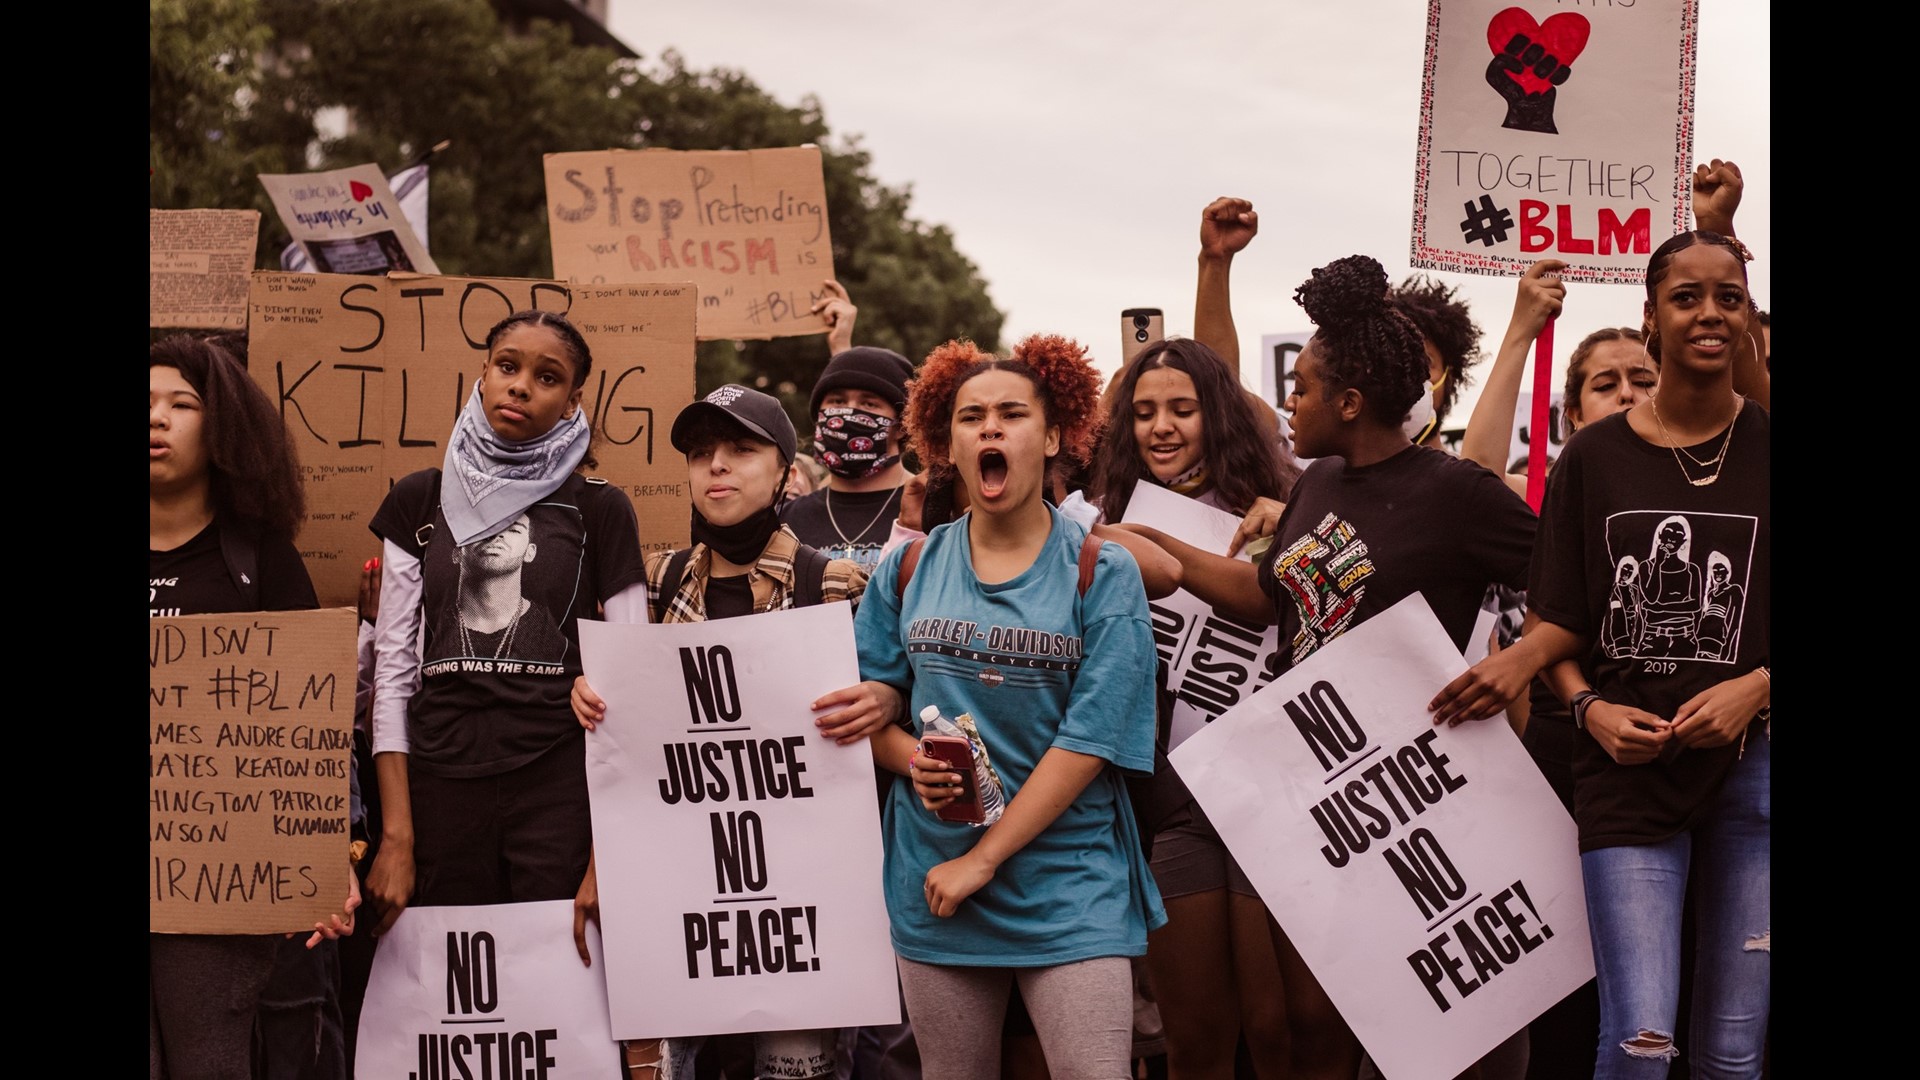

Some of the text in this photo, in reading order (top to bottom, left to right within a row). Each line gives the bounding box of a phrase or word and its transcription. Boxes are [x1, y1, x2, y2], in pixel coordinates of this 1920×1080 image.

[1441, 151, 1660, 202] TOGETHER
[366, 201, 389, 220] In
[555, 165, 823, 245] Stop Pretending
[1460, 194, 1651, 256] #BLM
[587, 241, 618, 263] your
[625, 234, 779, 275] RACISM
[1410, 258, 1437, 270] BLACK
[1440, 263, 1460, 273] LIVES
[1465, 266, 1506, 277] MATTER
[1430, 254, 1460, 264] JUSTICE
[1478, 261, 1503, 269] PEACE
[1491, 255, 1515, 263] BLACK
[291, 277, 316, 287] WANNA
[628, 289, 649, 297] HAVE
[663, 288, 686, 296] GUN"
[265, 305, 296, 314] DIDN'T
[302, 307, 322, 315] EVEN
[339, 282, 572, 353] STOP
[603, 324, 625, 333] SHOT
[320, 466, 334, 474] YOU
[338, 465, 374, 473] WOULDN'T
[634, 482, 688, 497] BREATHE"
[1277, 540, 1319, 579] JUSTICE
[1300, 555, 1332, 594] UNITY
[1327, 545, 1363, 572] LIBERTY
[1339, 564, 1372, 590] EQUAL
[202, 621, 280, 657] ISN'T
[908, 617, 1083, 659] HARLEY-DAVIDSON
[462, 661, 493, 672] WAS
[497, 662, 523, 673] THE
[526, 664, 565, 676] SAME
[909, 645, 1078, 670] MOTORCYCLES
[1643, 660, 1677, 675] 2019
[207, 665, 335, 715] #BLM
[679, 644, 742, 724] NO
[150, 722, 353, 750] MES ANDRE GLADEN
[1282, 680, 1368, 773] NO
[235, 755, 310, 779] KEATON
[315, 758, 346, 779] OTIS
[658, 736, 814, 805] JUSTICE
[269, 789, 345, 811] PATRICK
[1308, 728, 1468, 869] JUSTICE
[150, 815, 346, 843] NSON KIMMONS
[710, 810, 768, 894] NO
[1381, 827, 1467, 922] NO
[683, 906, 820, 979] PEACE!
[1406, 879, 1555, 1013] PEACE!
[446, 931, 499, 1015] NO
[409, 1029, 557, 1080] JUSTICE
